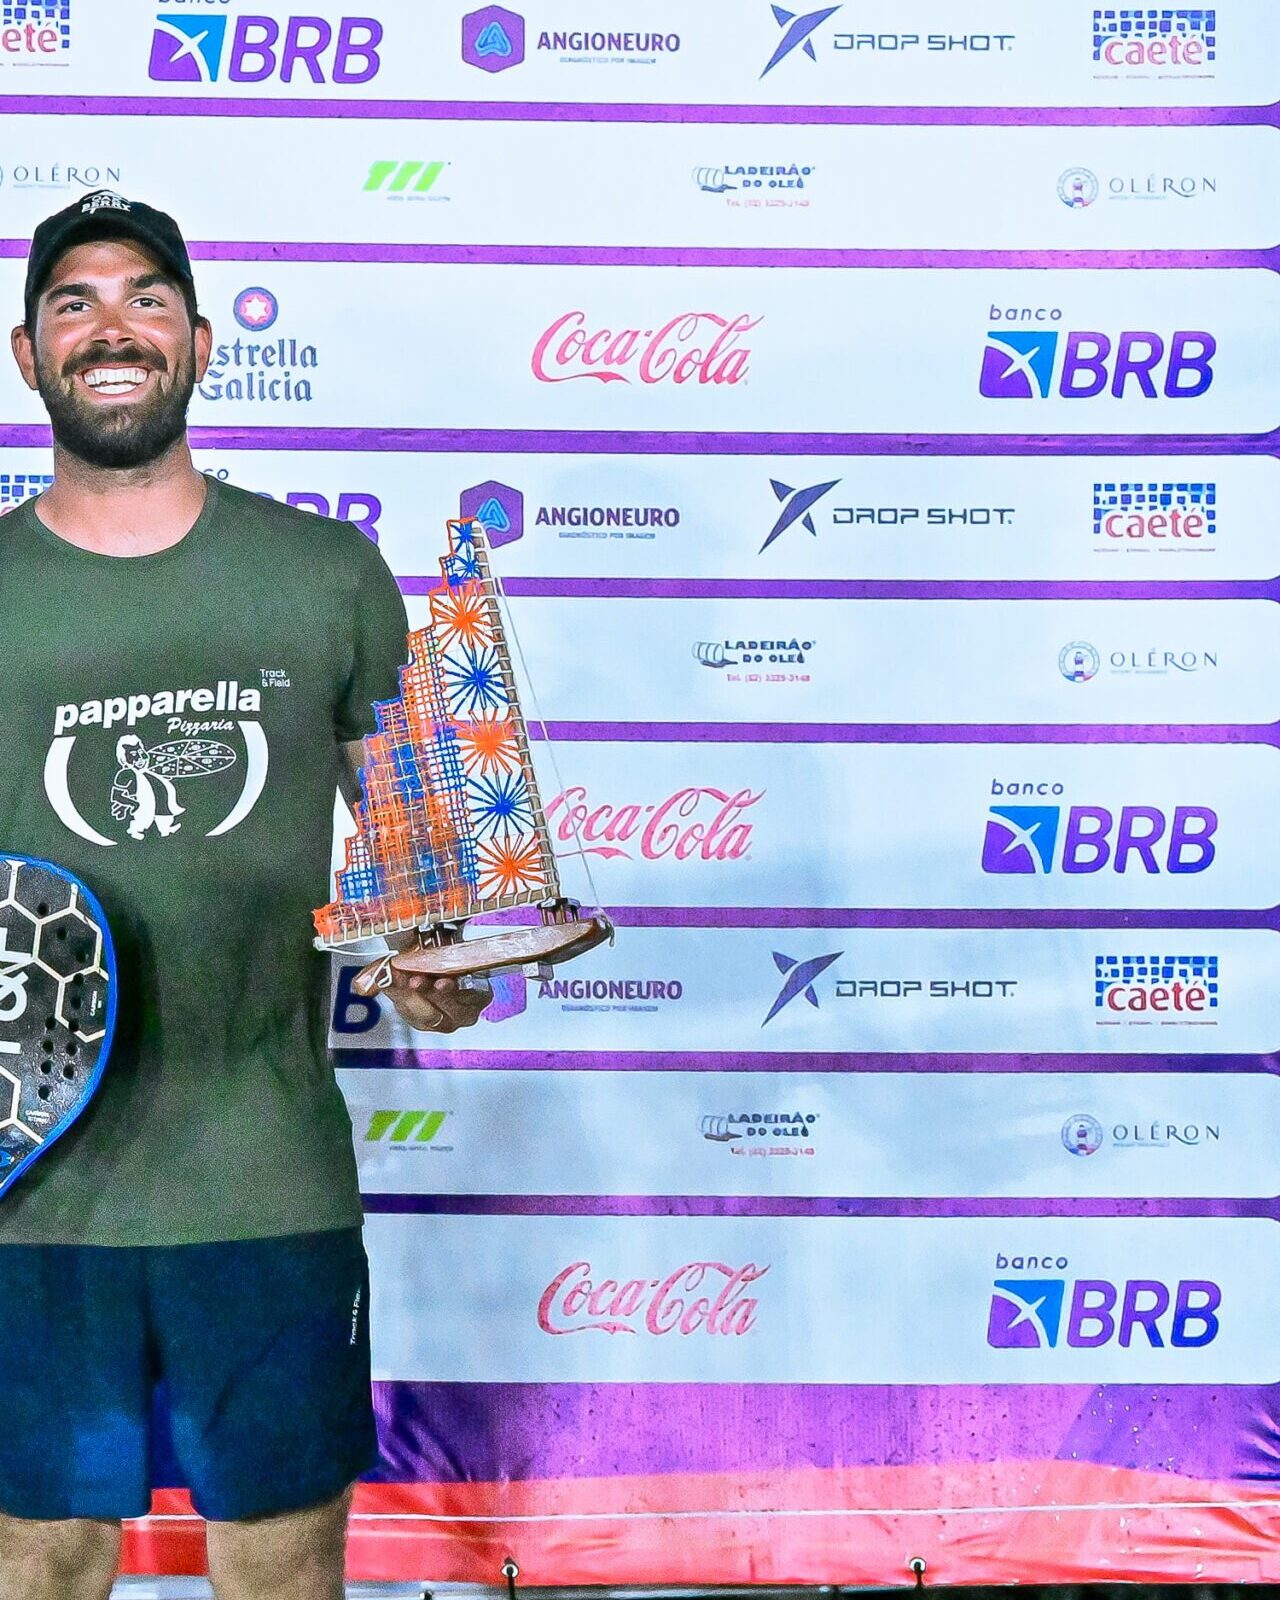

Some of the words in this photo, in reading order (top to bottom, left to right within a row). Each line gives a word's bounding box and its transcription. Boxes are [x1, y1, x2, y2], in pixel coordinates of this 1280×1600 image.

[228, 15, 384, 84] BRB
[537, 31, 680, 52] ANGIONEURO
[833, 34, 919, 51] DROP
[1105, 34, 1202, 64] caeté
[12, 162, 122, 188] OLÉRON
[742, 179, 763, 188] DO
[1109, 177, 1216, 199] OLÉRON
[989, 304, 1062, 321] banco
[208, 337, 319, 368] strella
[531, 310, 765, 386] Coca-Cola
[1061, 331, 1217, 399] BRB
[535, 507, 680, 527] ANGIONEURO
[833, 508, 919, 524] DROP
[1105, 505, 1204, 539] caeté
[742, 654, 763, 663] DO
[1110, 648, 1217, 673] OLÉRON
[260, 669, 286, 678] Track
[269, 679, 290, 687] Field
[54, 681, 261, 735] papparella
[167, 717, 235, 735] Pizzaria
[991, 778, 1064, 796] banco
[544, 786, 767, 861] Coca-Cola
[1062, 806, 1218, 874] BRB
[538, 980, 683, 1000] ANGIONEURO
[835, 980, 922, 998] DROP
[1107, 981, 1206, 1011] caeté
[746, 1127, 767, 1136] DO
[1113, 1121, 1219, 1146] OLÉRON
[996, 1252, 1068, 1271] banco
[537, 1262, 770, 1336] Coca-Cola
[1066, 1279, 1222, 1348] BRB
